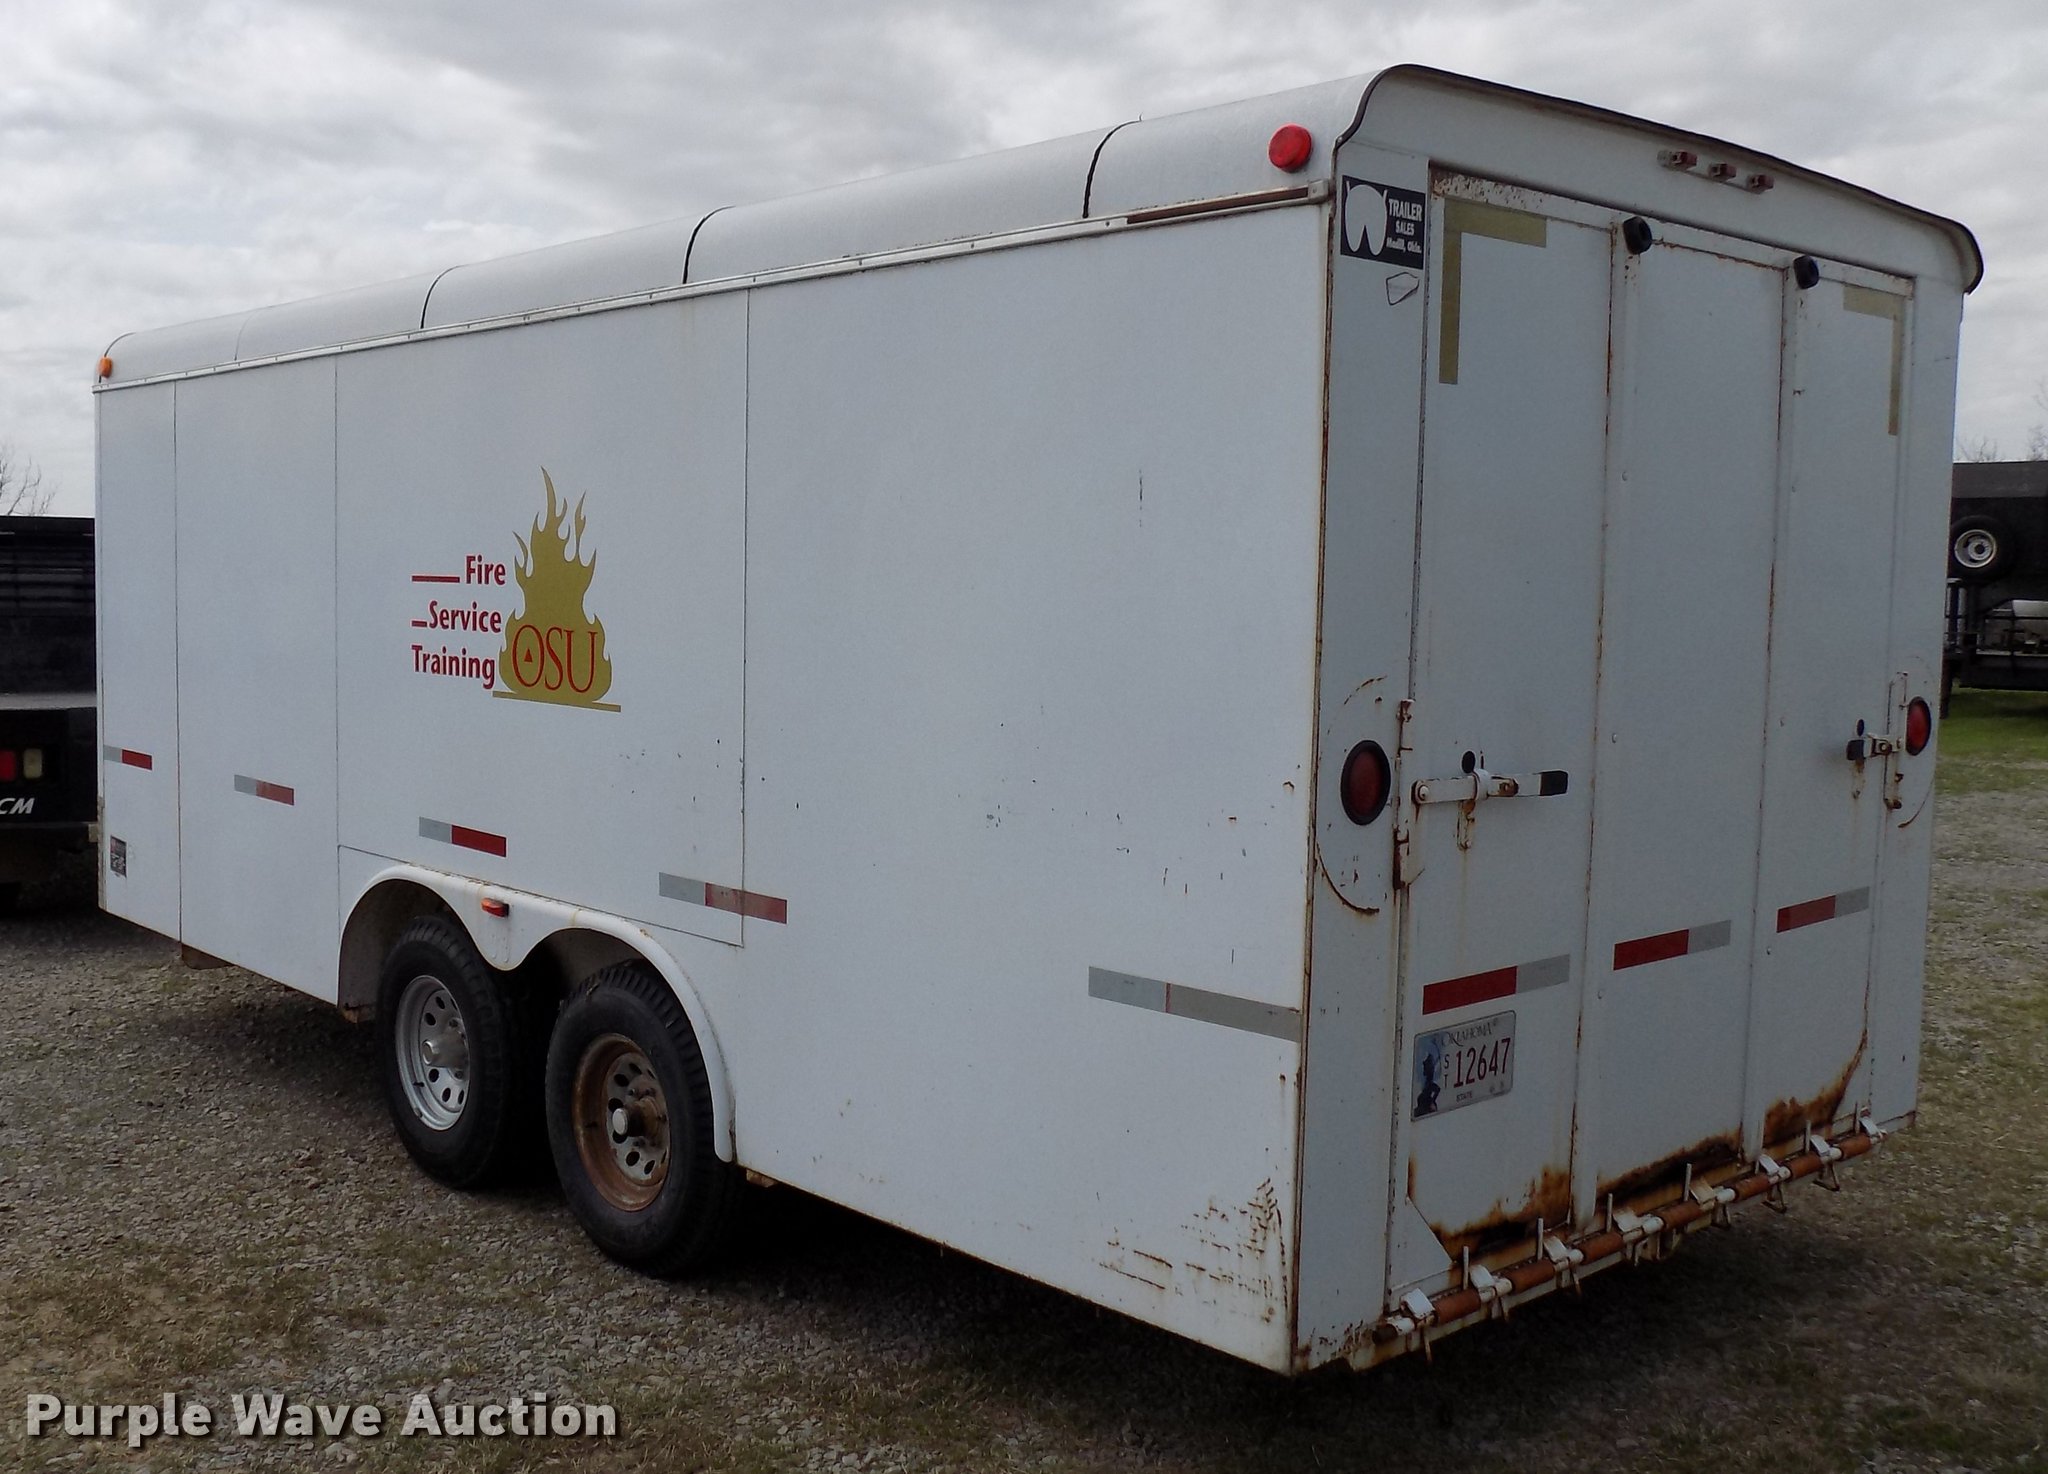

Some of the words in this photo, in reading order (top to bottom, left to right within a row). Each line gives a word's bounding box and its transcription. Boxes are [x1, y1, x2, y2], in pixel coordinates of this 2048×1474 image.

[1388, 198, 1423, 222] TRAILER
[1395, 221, 1415, 236] SALES
[466, 554, 506, 585] Fire
[429, 600, 502, 633] Service
[411, 645, 495, 689] Training
[512, 624, 598, 693] OSU
[0, 797, 35, 815] CM
[1453, 1037, 1511, 1088] 12647
